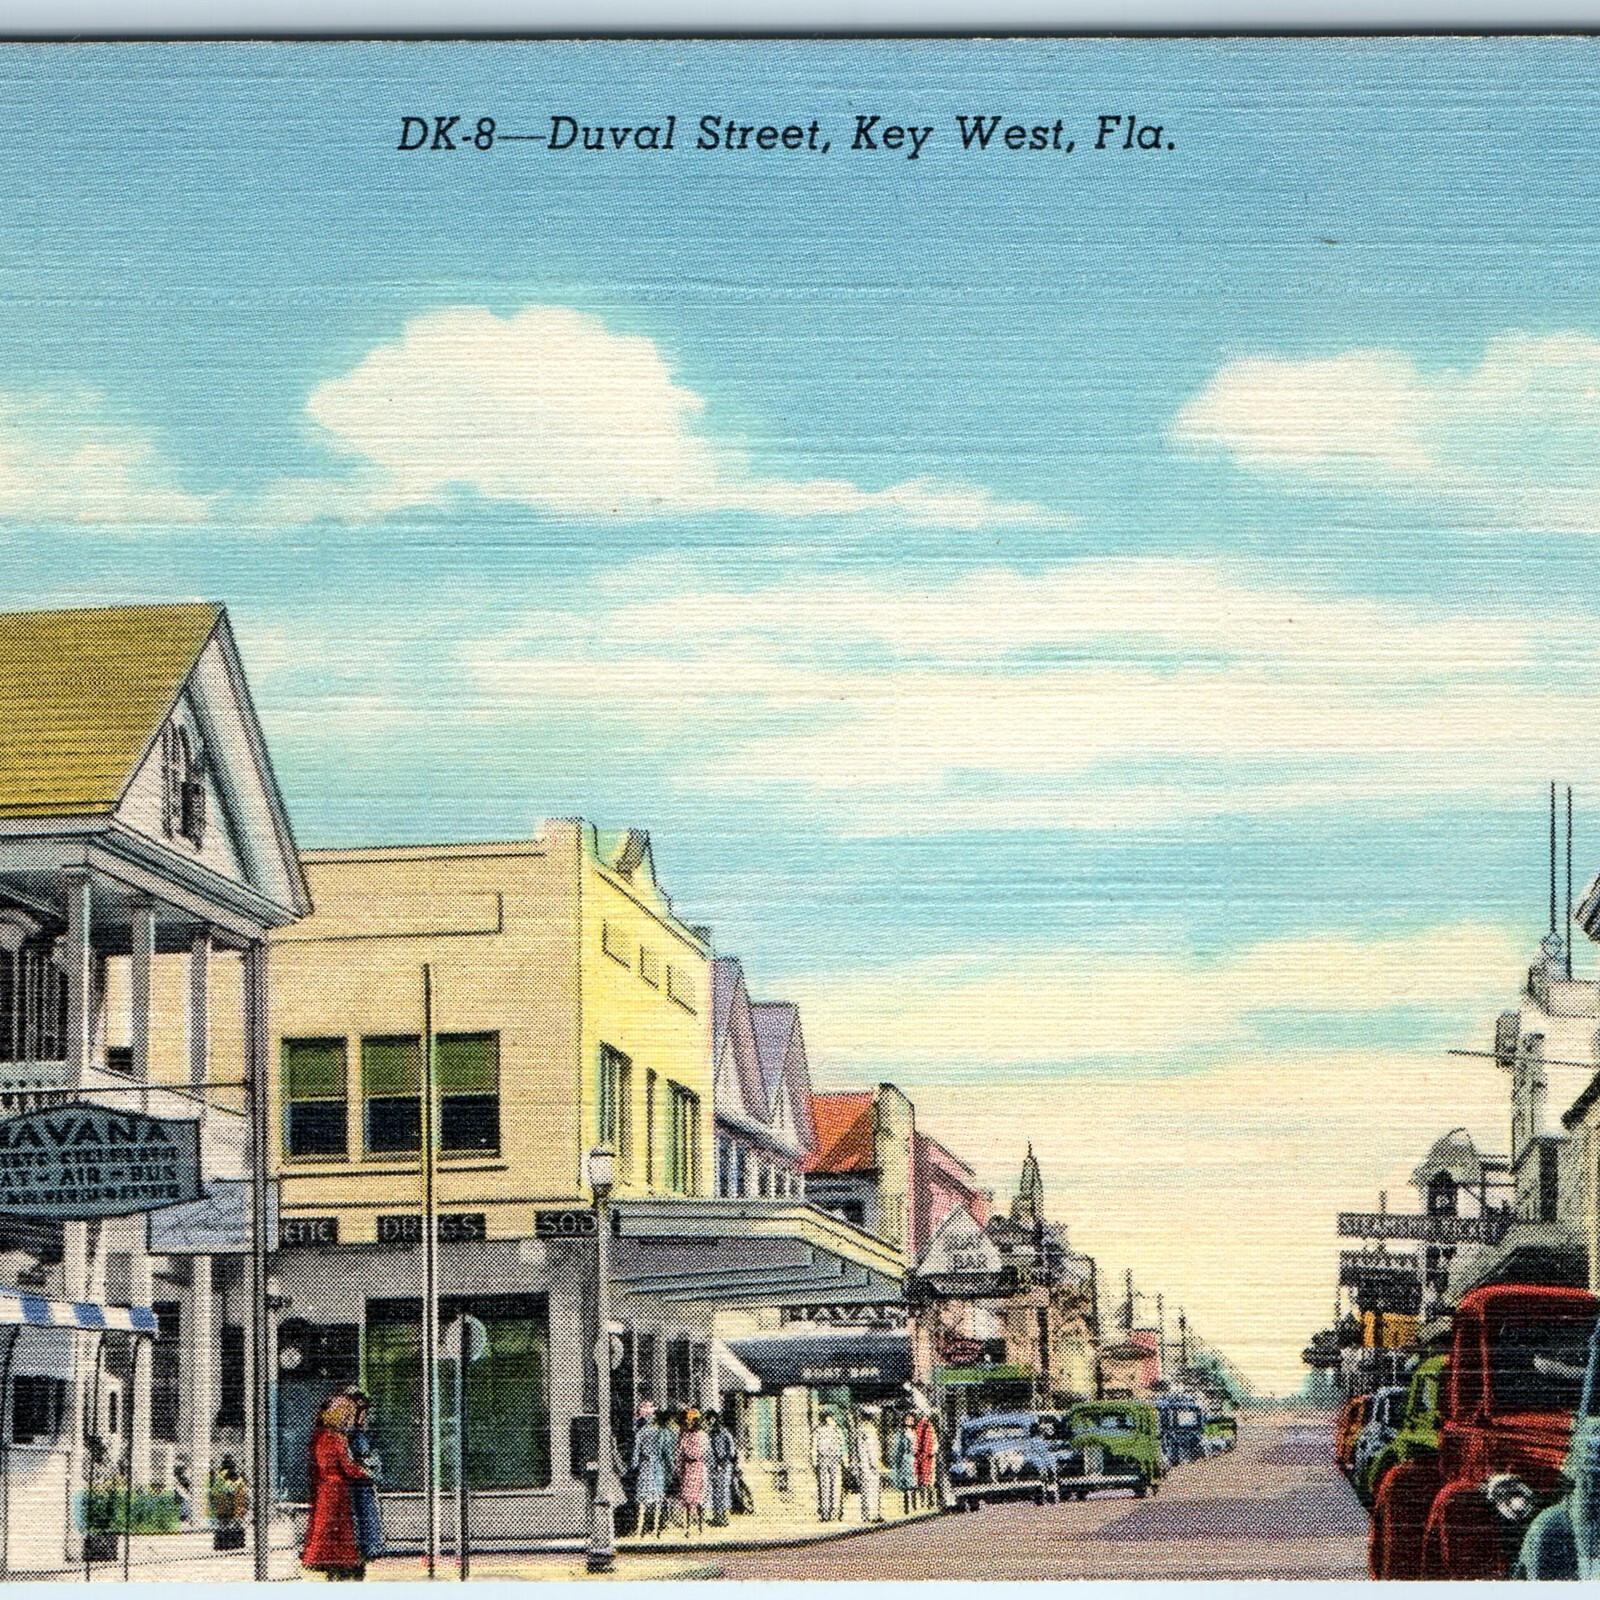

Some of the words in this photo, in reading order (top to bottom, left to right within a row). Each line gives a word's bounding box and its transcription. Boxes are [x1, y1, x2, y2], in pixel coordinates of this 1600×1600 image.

[60, 1167, 101, 1186] AIR
[130, 1165, 177, 1182] BUS
[383, 1215, 480, 1239] DRGS
[952, 1253, 988, 1271] BAR
